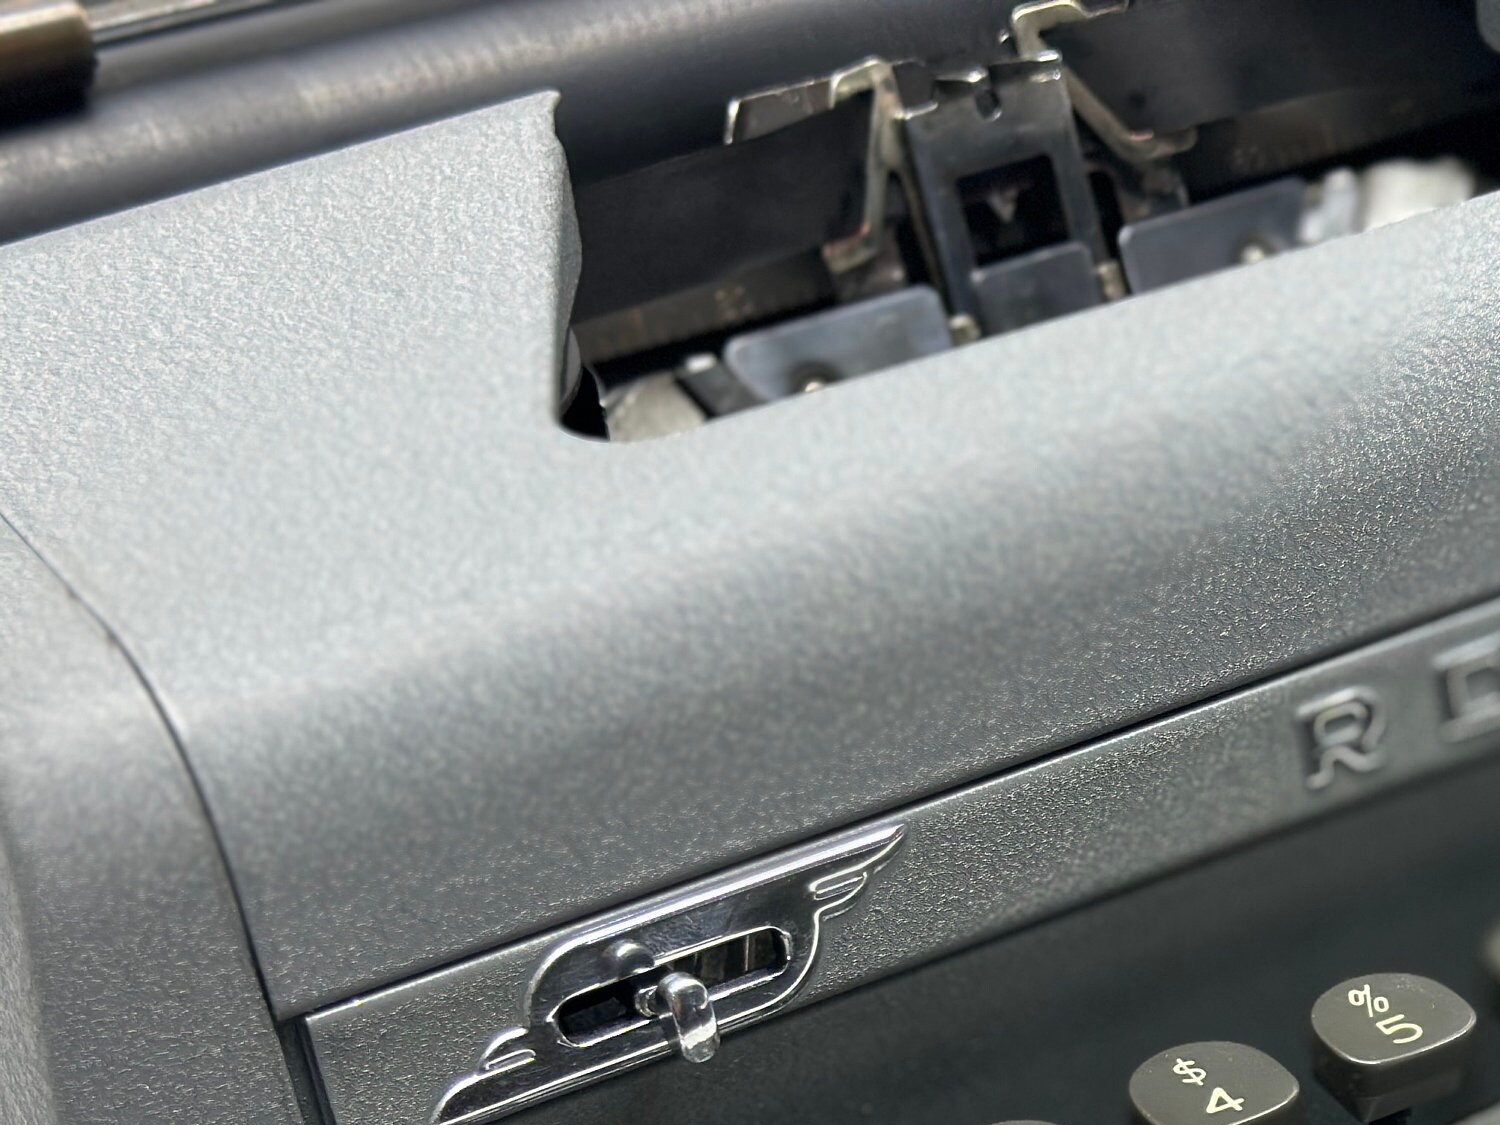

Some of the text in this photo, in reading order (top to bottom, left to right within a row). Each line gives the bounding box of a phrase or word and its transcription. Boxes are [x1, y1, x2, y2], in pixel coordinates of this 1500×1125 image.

[1347, 983, 1390, 1018] %
[1375, 1013, 1424, 1045] 5
[1172, 1058, 1208, 1087] $
[1205, 1086, 1246, 1115] 4
